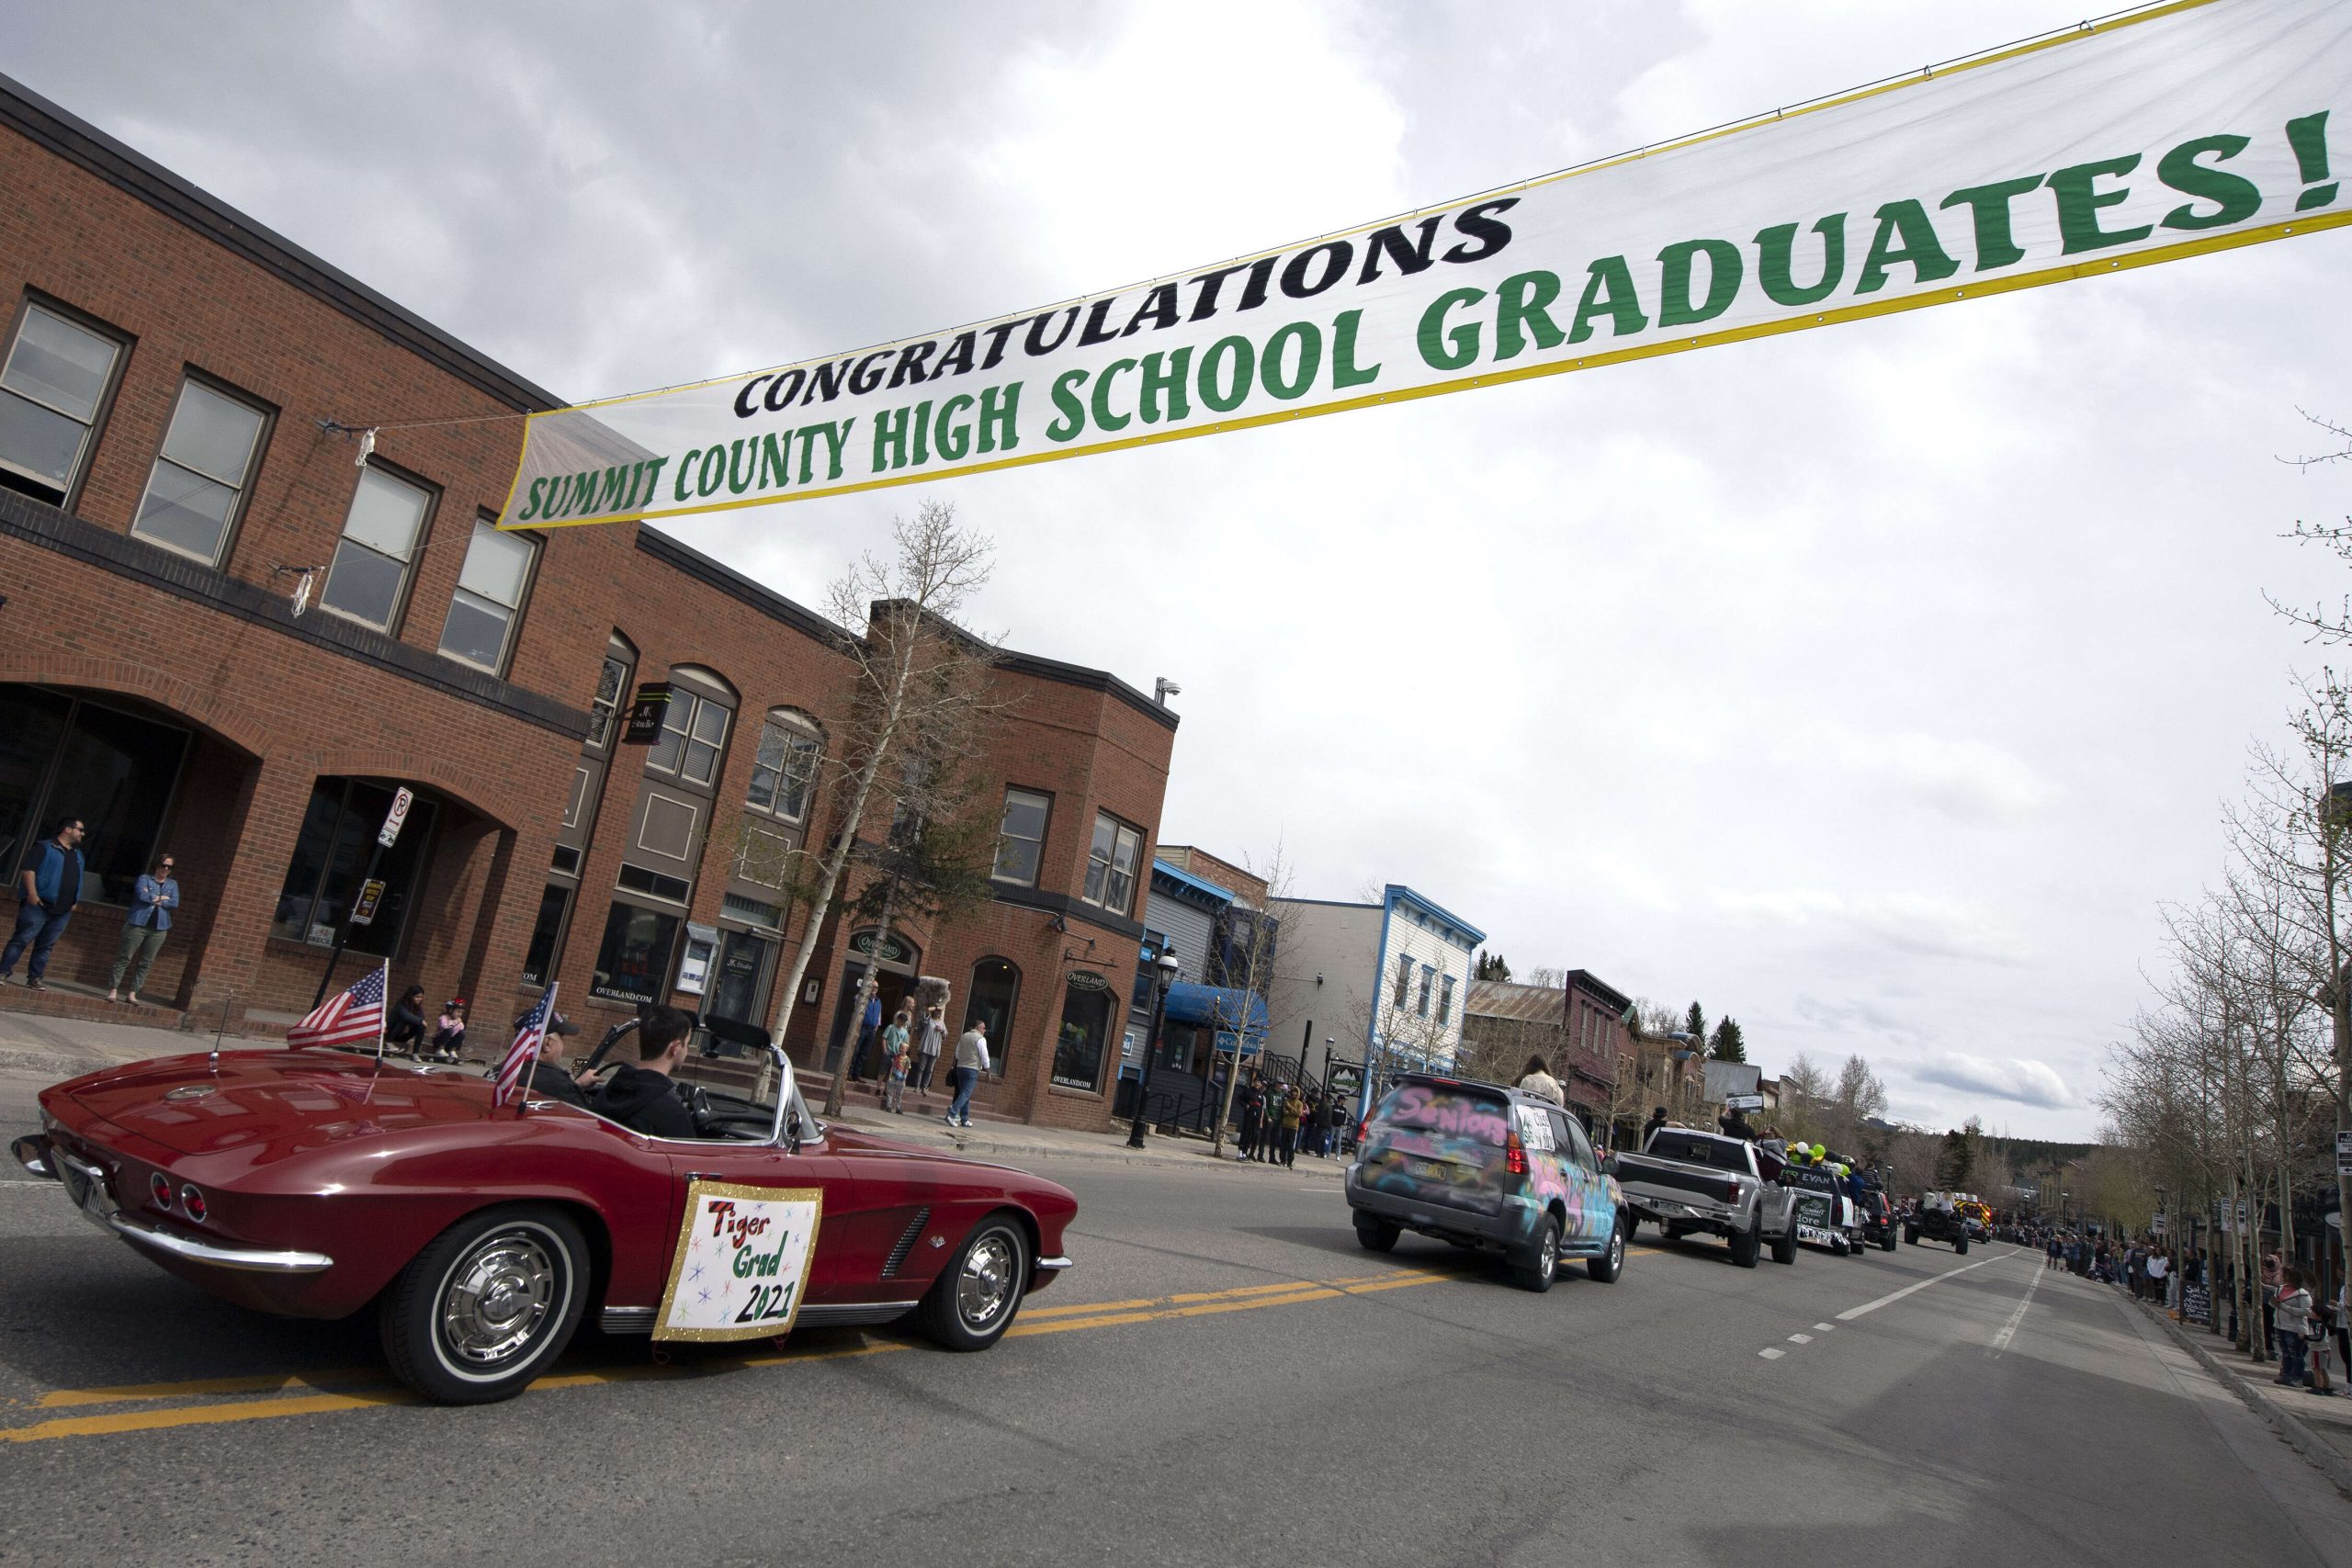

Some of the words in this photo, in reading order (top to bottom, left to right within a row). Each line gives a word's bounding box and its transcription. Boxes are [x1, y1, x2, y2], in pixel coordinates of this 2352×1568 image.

[519, 456, 670, 521] SUMMIT
[674, 416, 857, 502] COUNTY
[872, 381, 1025, 473] HIGH
[1046, 309, 1383, 443] SCHOOL
[1417, 109, 2340, 371] GRADUATES!
[734, 197, 1521, 419] CONGRATULATIONS
[596, 987, 652, 1004] OVERLAND.COM
[1067, 972, 1106, 987] OVERLAND
[1053, 1075, 1091, 1089] OVERLAND.COM
[1802, 1173, 1830, 1184] EVAN
[707, 1200, 771, 1249] Tiger
[732, 1230, 789, 1279] Grad
[734, 1280, 795, 1324] 2021
